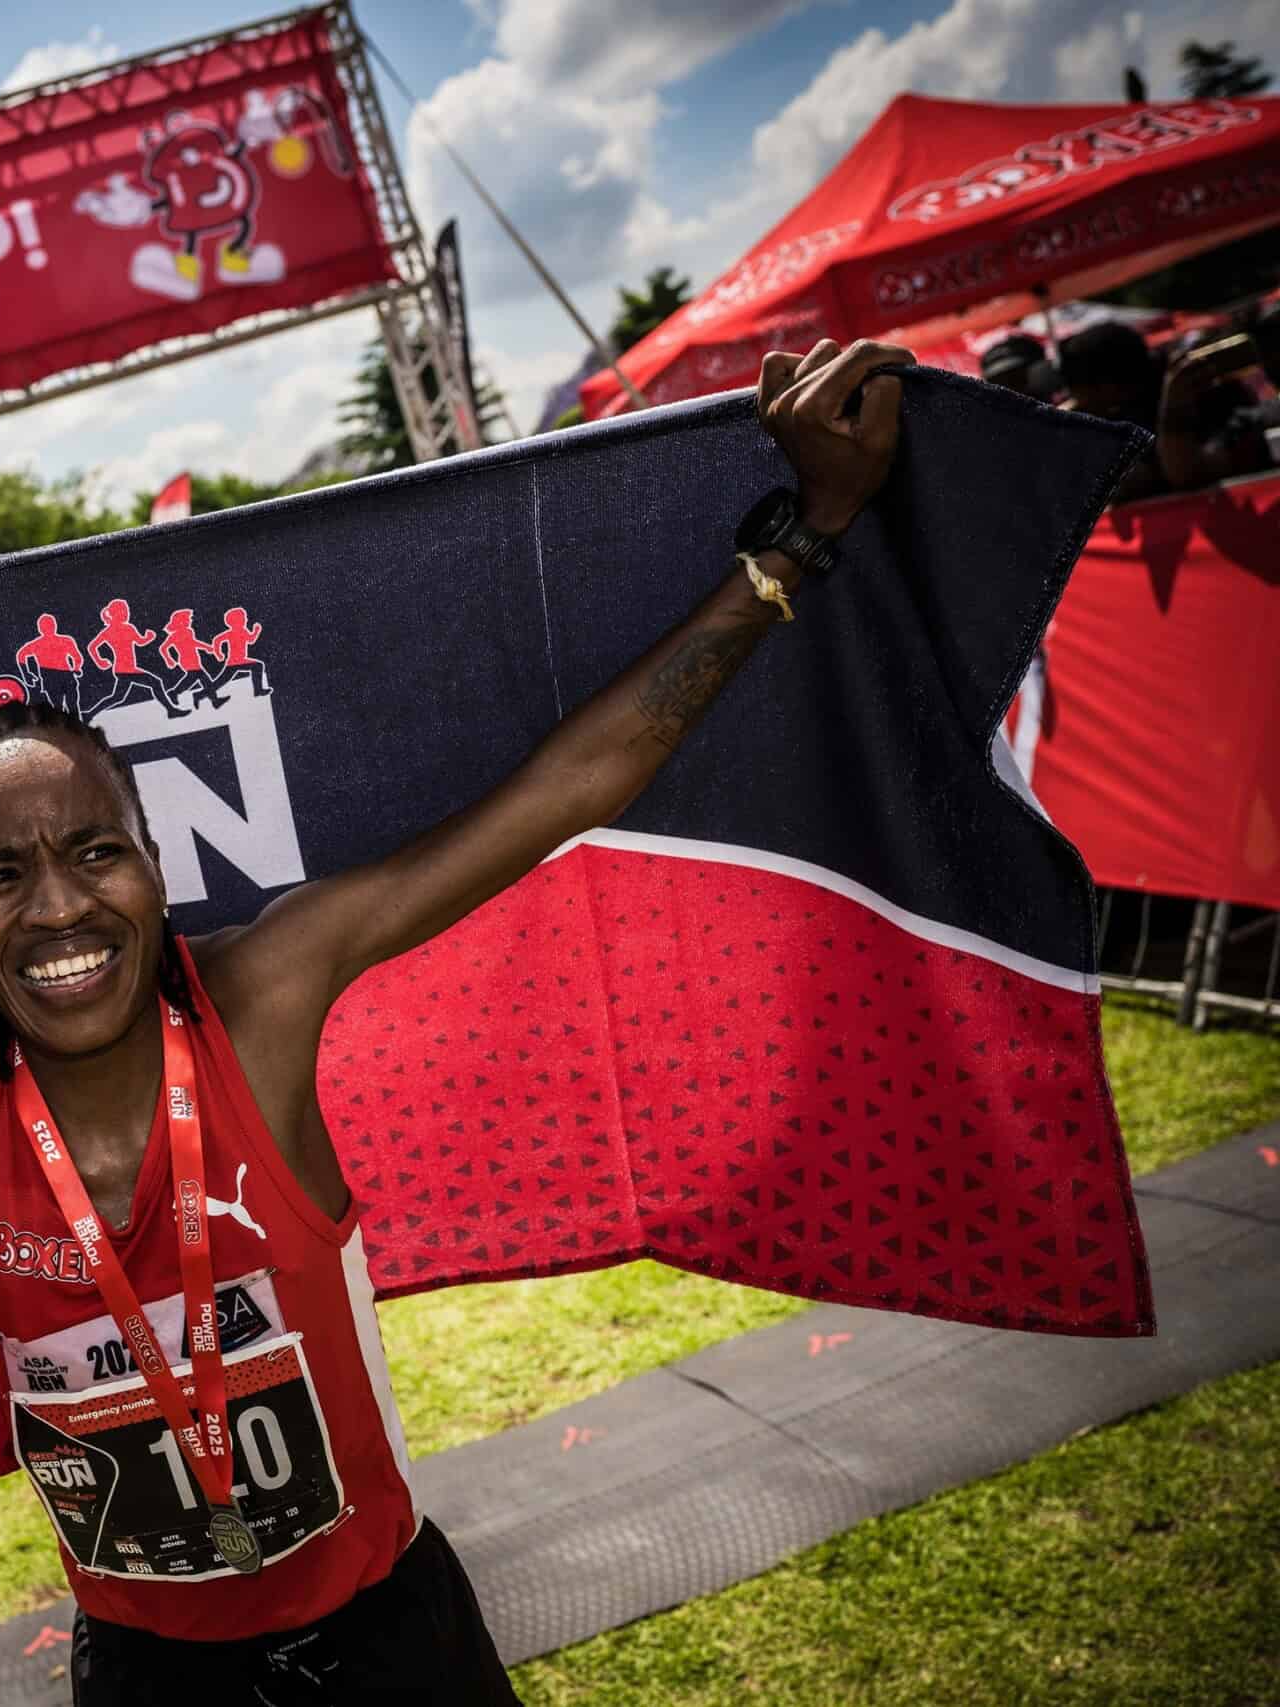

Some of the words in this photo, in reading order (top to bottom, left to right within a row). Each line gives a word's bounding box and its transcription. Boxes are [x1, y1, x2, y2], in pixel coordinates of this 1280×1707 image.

[886, 100, 1263, 225] BOXER
[168, 1085, 187, 1120] RUN
[31, 1119, 62, 1164] 2025
[179, 1179, 202, 1247] BOXER
[73, 1220, 102, 1267] POWER
[199, 1302, 216, 1353] POWER
[216, 1292, 254, 1328] SA
[23, 1356, 55, 1369] ASA
[122, 1313, 166, 1376] BOXER
[67, 1405, 121, 1423] Emergency
[121, 1396, 156, 1412] numbe
[205, 1413, 225, 1457] 2025
[31, 1457, 97, 1488] RUN
[148, 1404, 293, 1511] 10
[247, 1516, 278, 1530] RAW:
